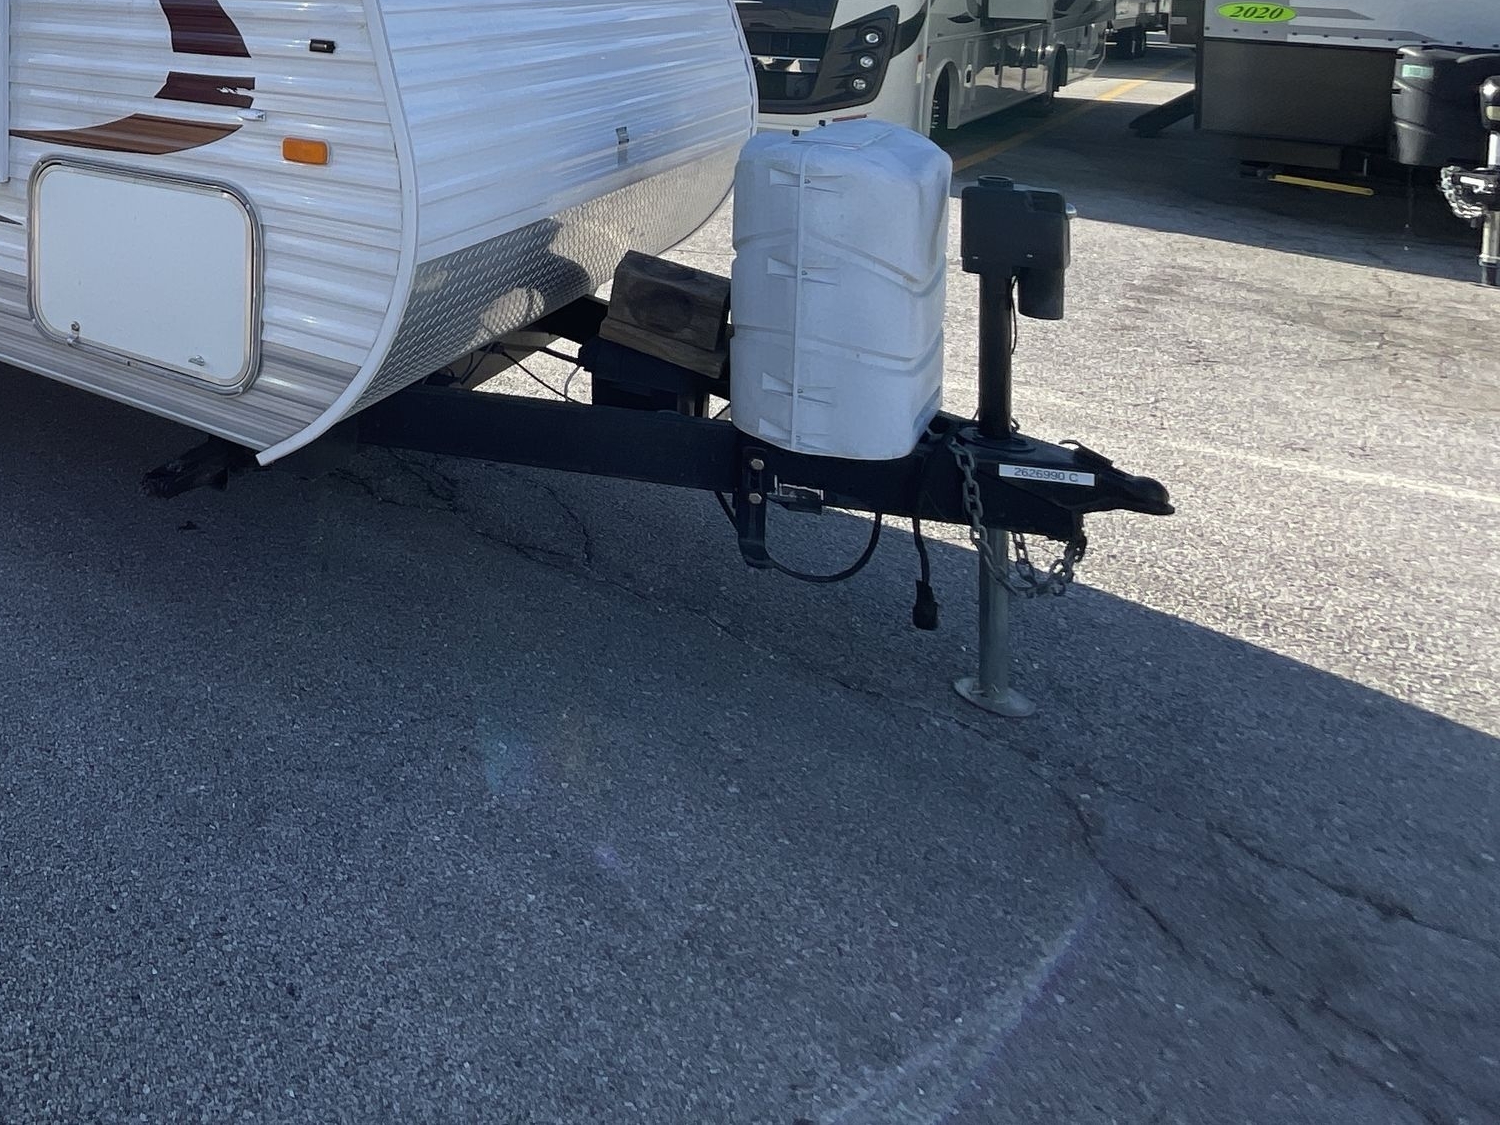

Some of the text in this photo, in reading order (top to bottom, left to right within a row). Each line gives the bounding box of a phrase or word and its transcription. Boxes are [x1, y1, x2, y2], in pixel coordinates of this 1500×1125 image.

[1229, 5, 1284, 20] 2020
[1013, 467, 1079, 483] 2626990 C
